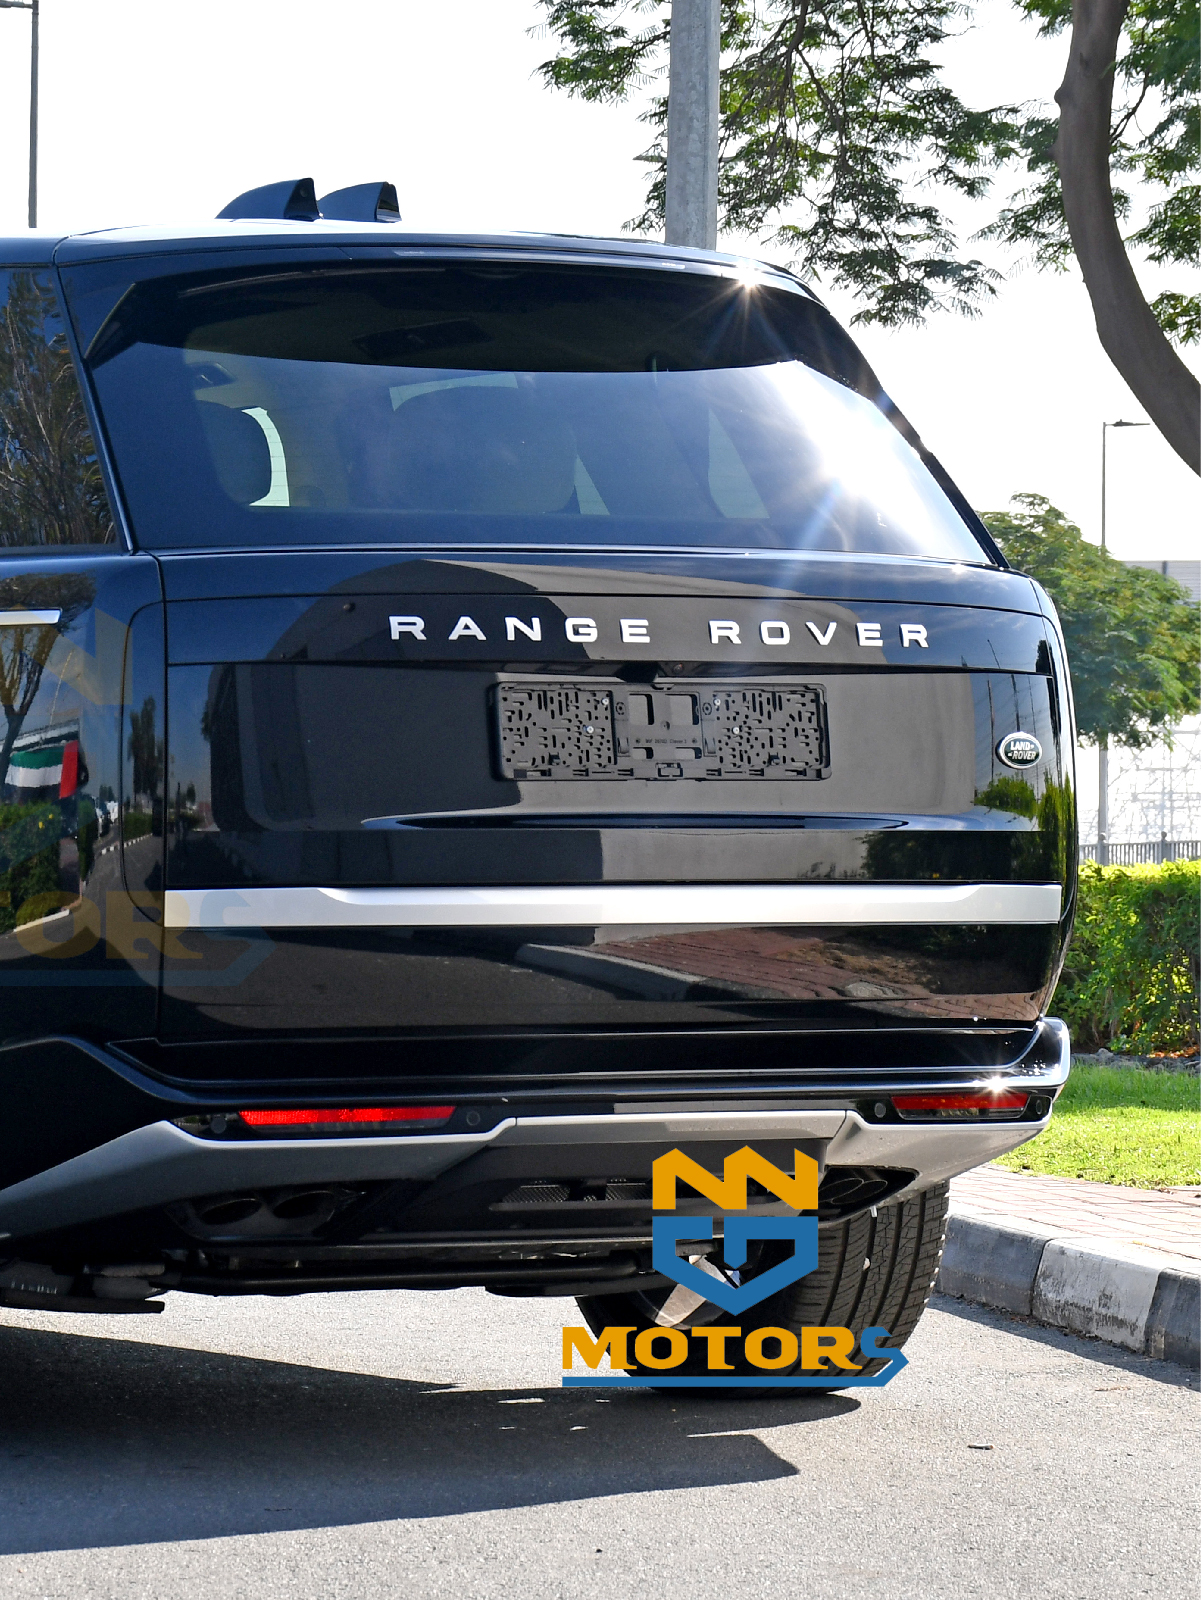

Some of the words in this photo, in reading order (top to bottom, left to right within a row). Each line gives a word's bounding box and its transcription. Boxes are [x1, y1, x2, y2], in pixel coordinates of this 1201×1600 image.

[388, 615, 651, 644] RANGE
[709, 620, 929, 648] ROVER
[1010, 740, 1031, 751] LAND
[1011, 750, 1037, 760] ROVER
